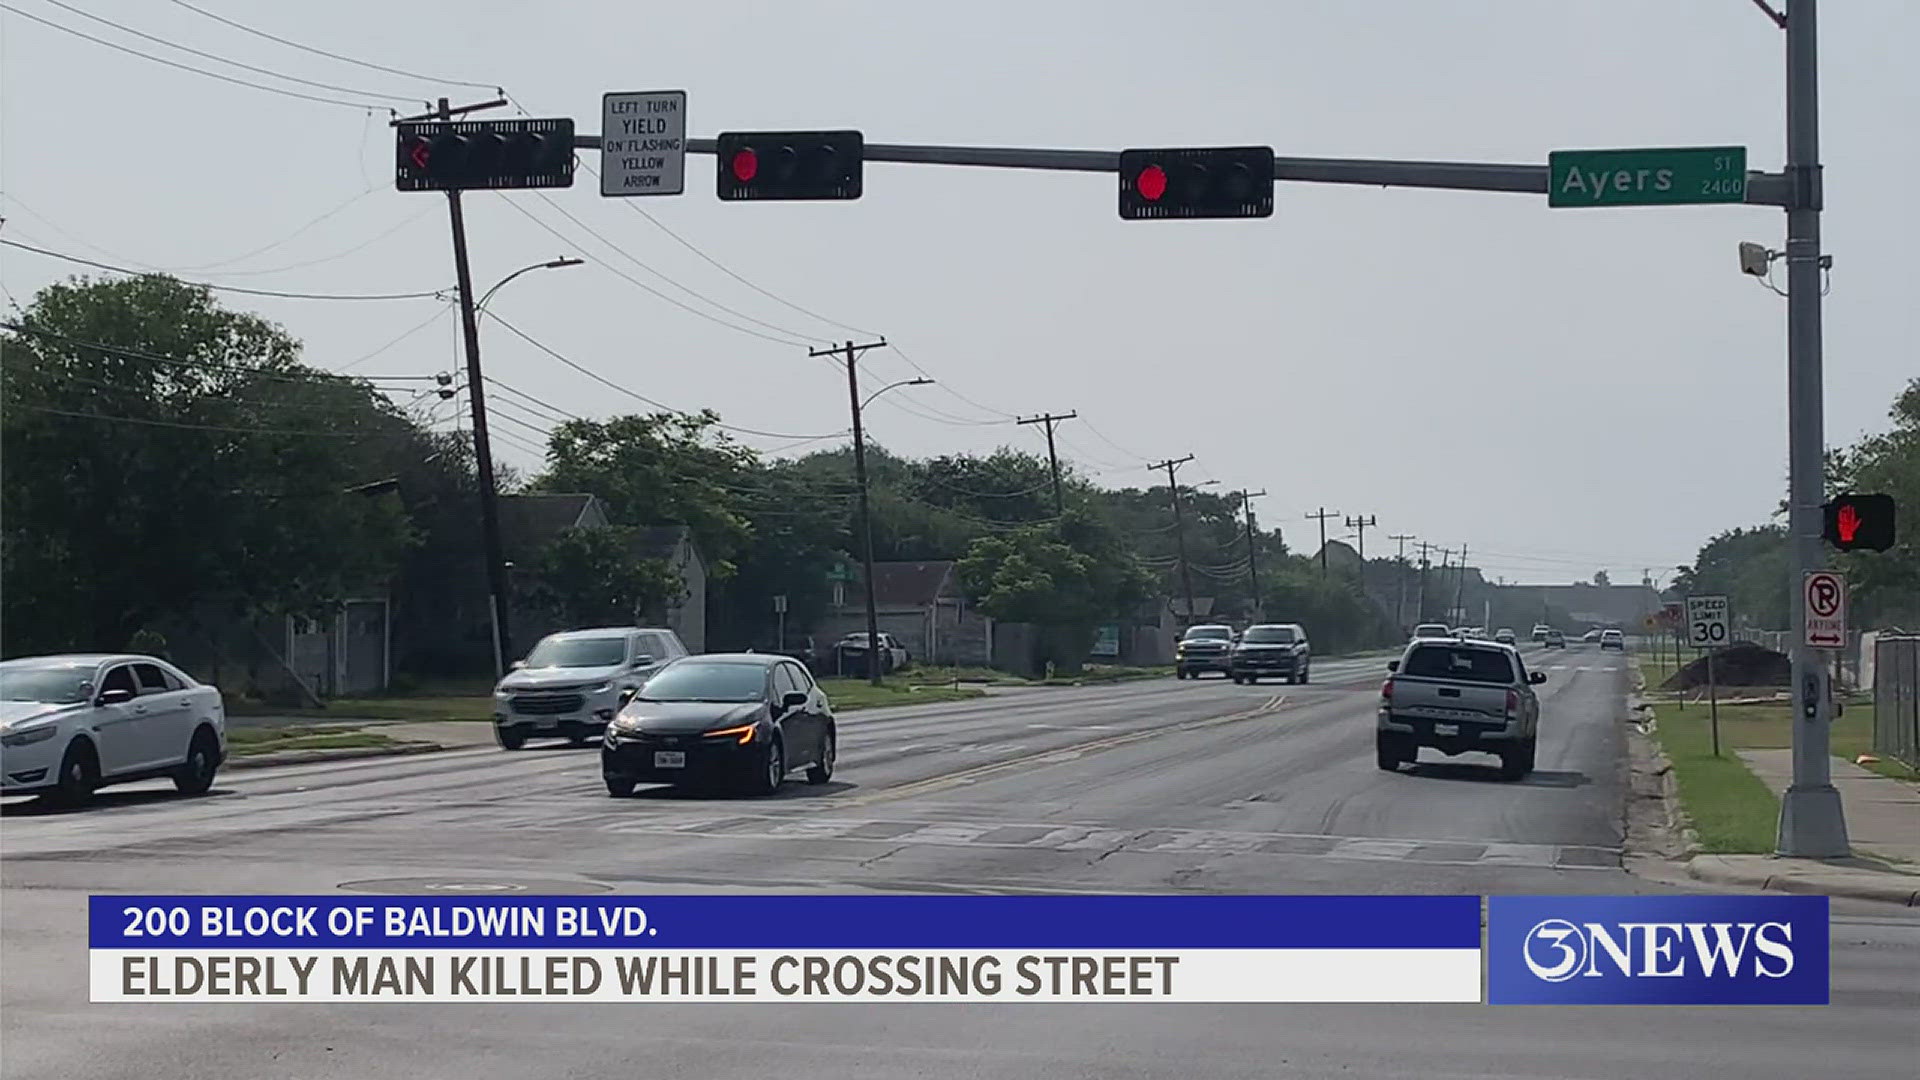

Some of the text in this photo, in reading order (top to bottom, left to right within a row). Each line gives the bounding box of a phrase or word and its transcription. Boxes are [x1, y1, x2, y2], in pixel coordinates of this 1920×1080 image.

[611, 100, 678, 114] LEFT TURN
[622, 118, 666, 134] YIELD
[606, 138, 681, 152] ON FLASHING
[622, 157, 665, 170] YELLOW
[623, 175, 660, 188] ARROW
[1562, 156, 1732, 199] Ayers ST
[1701, 179, 1742, 195] 2400
[1690, 600, 1726, 610] SPEED
[1693, 611, 1721, 621] LIMIT
[1694, 622, 1725, 641] 30
